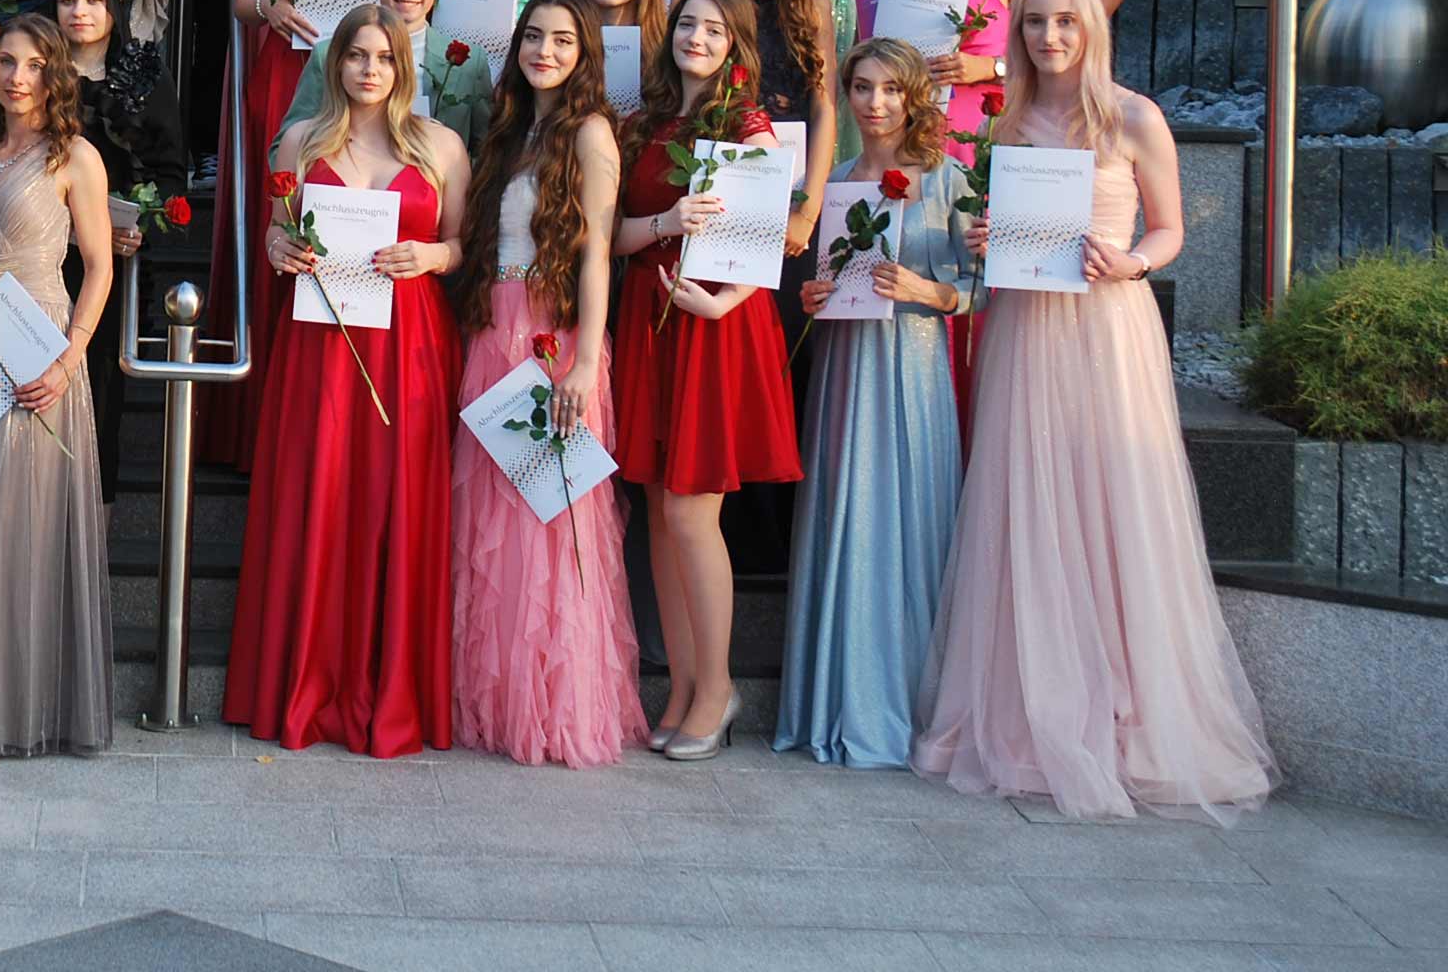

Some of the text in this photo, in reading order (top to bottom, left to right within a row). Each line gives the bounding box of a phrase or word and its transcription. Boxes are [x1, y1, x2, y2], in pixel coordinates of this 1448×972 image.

[1000, 163, 1083, 178] Abschlusszeugnis
[311, 201, 390, 218] Abschlusszeugnis
[477, 378, 538, 429] Abschlusszeugnis
